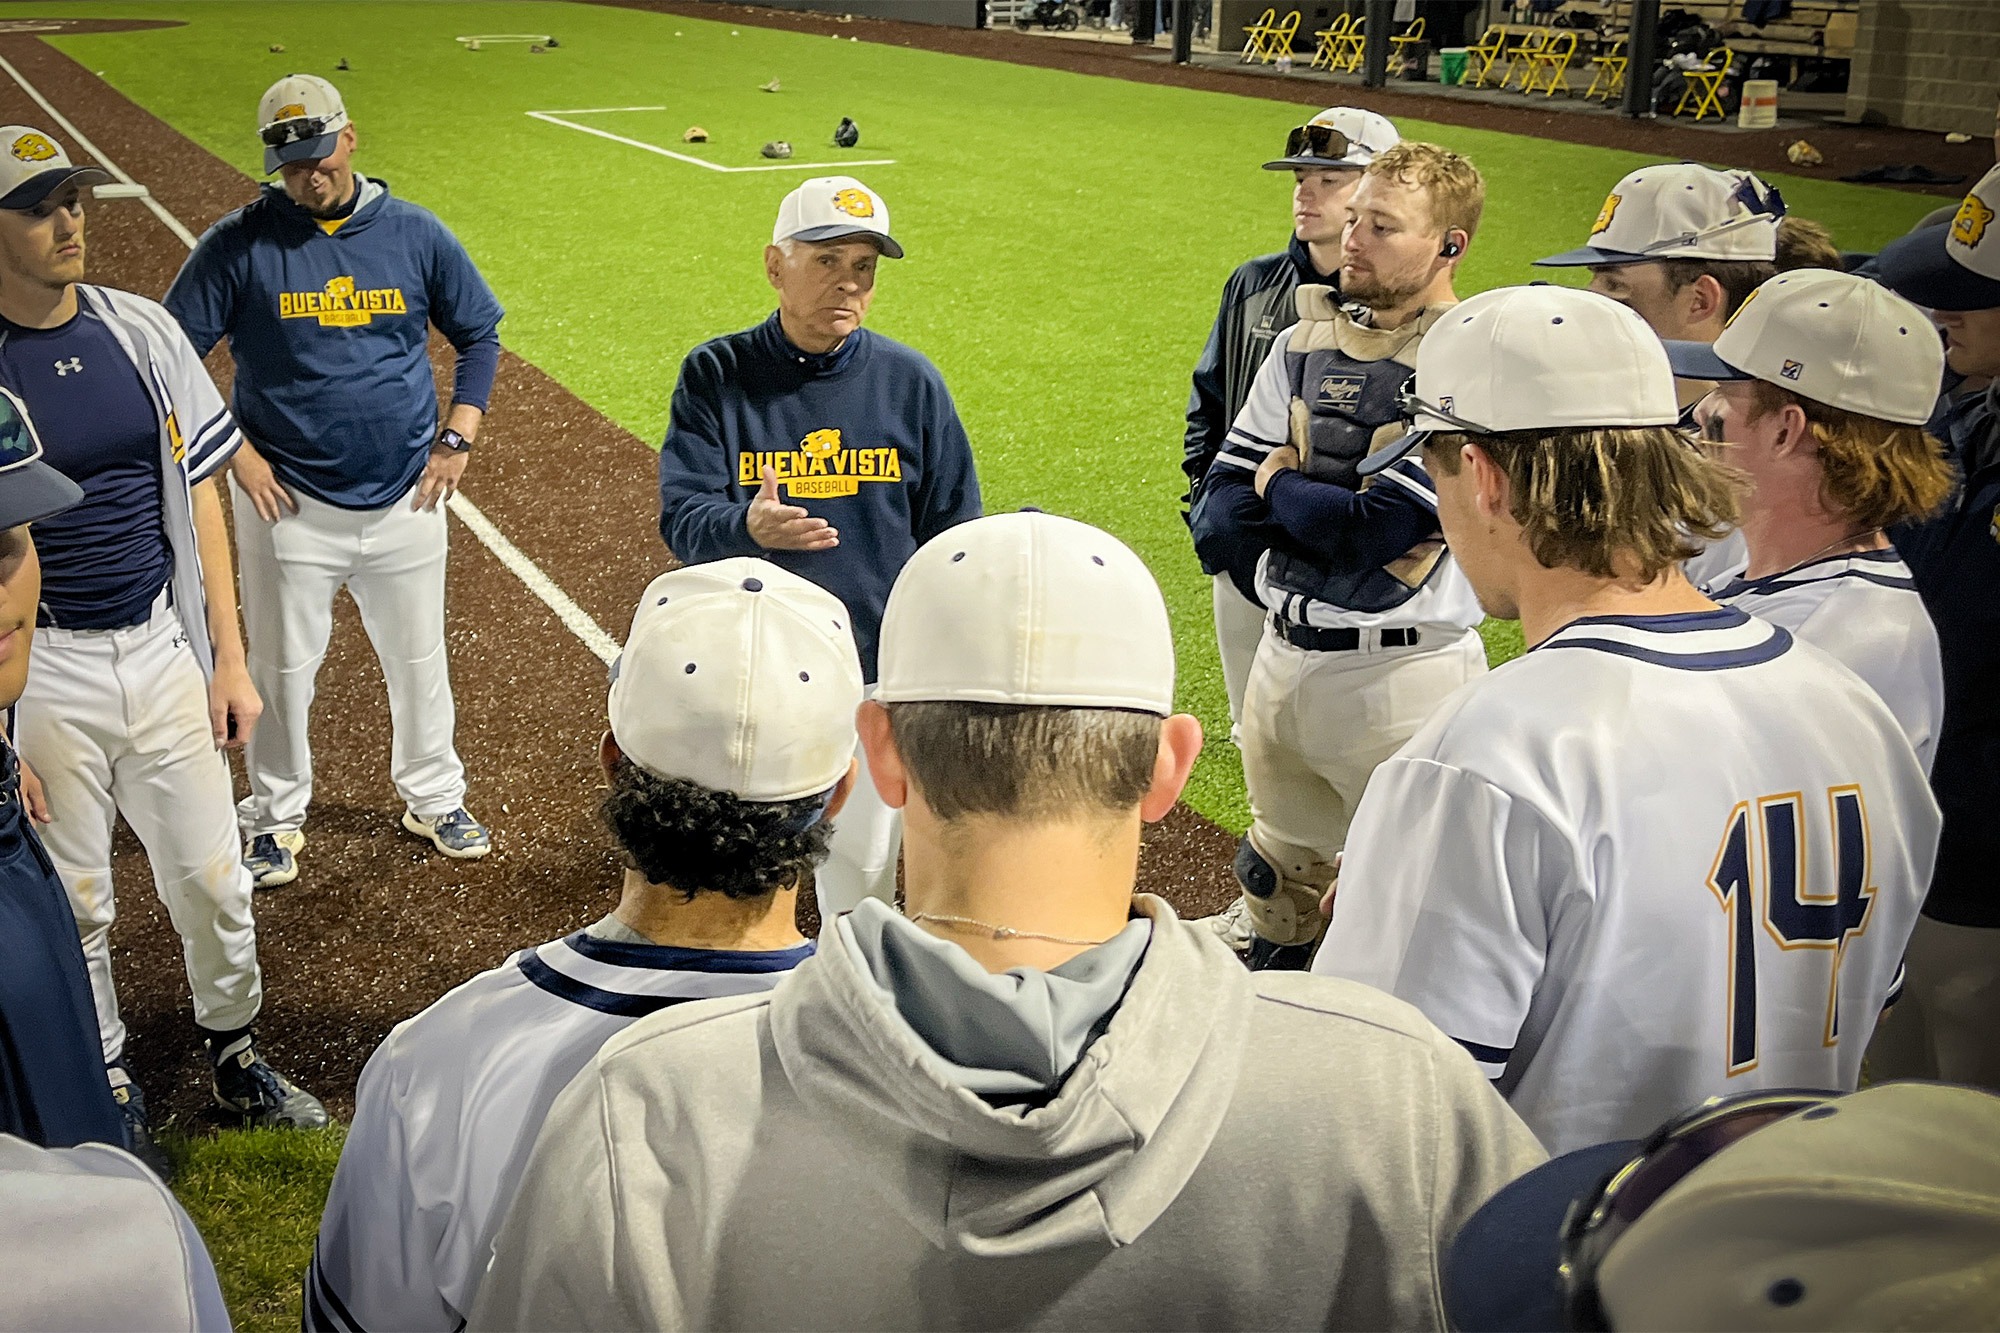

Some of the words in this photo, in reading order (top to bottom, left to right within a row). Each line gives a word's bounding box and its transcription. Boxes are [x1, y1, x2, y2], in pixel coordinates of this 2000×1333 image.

[280, 291, 347, 315] BUENA
[349, 288, 407, 310] VISTA
[324, 313, 363, 324] BASEBALL
[739, 450, 828, 481] BUENA
[832, 448, 902, 478] VISTA
[796, 480, 851, 495] BASEBALL
[1705, 783, 1878, 1079] 14
